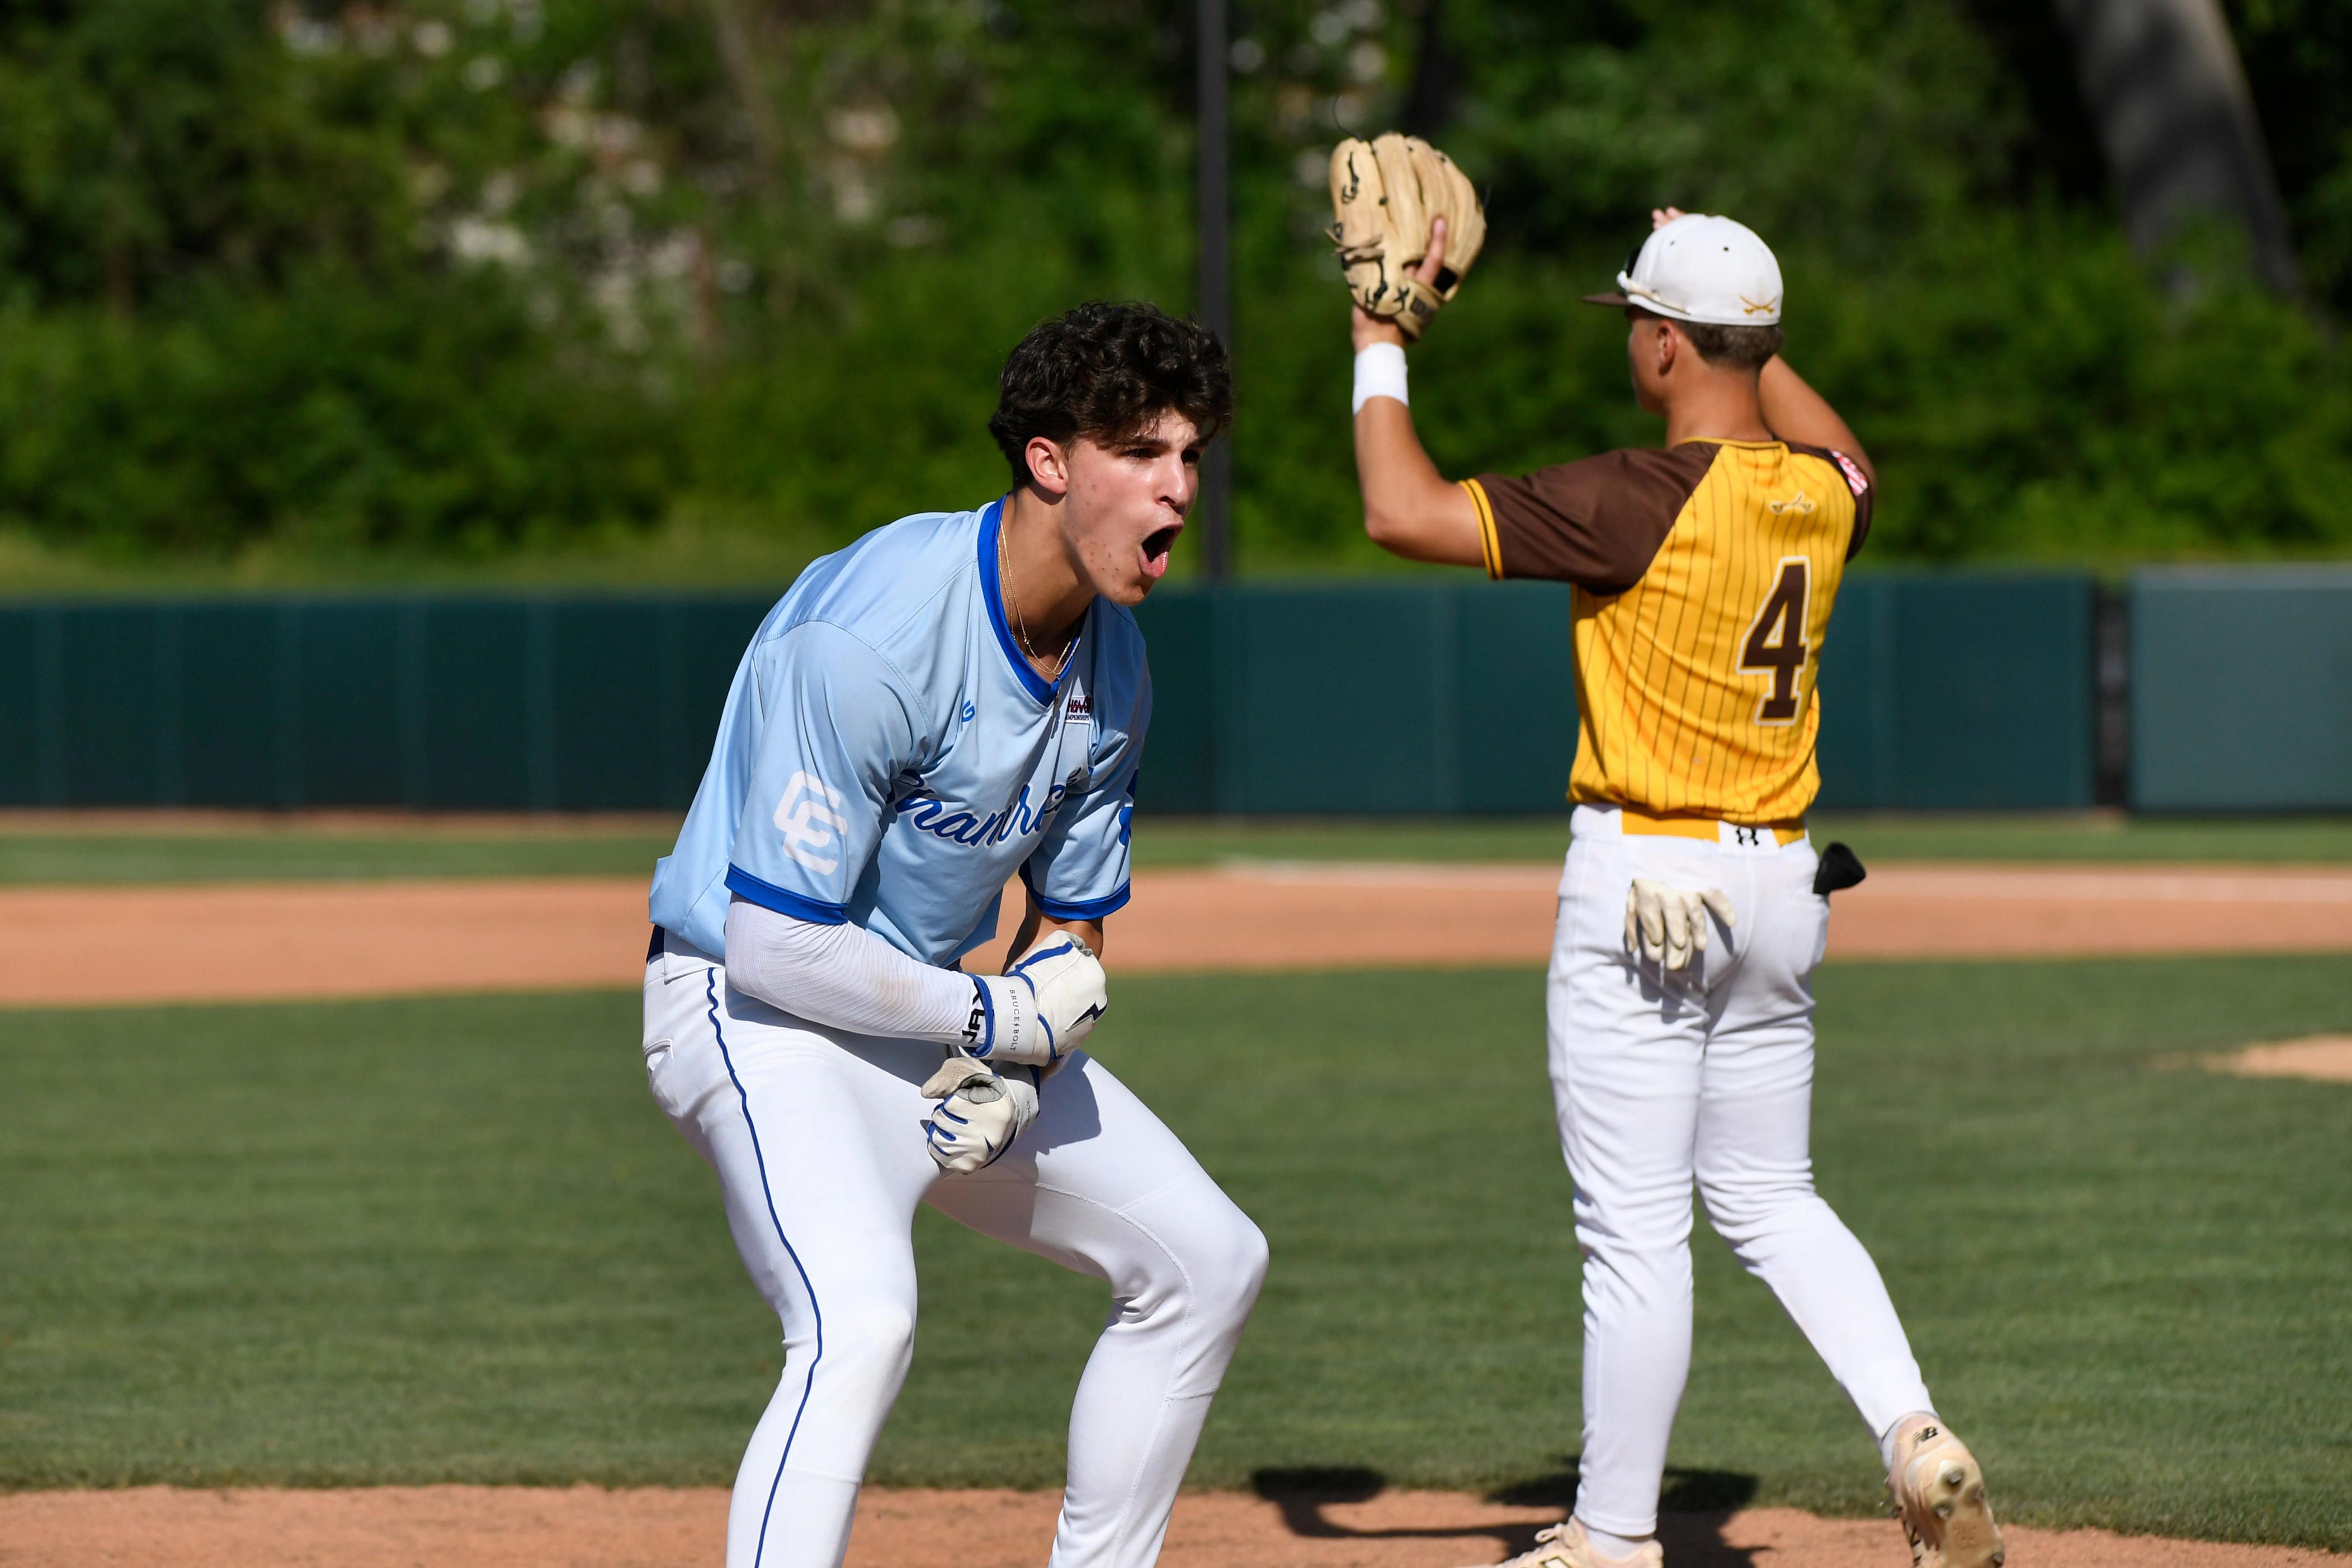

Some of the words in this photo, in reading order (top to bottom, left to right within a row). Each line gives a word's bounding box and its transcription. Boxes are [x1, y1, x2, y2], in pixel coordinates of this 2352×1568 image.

[1736, 555, 1811, 726] 4
[1009, 989, 1020, 1022] BRUCE
[1009, 1028, 1019, 1051] BOLT
